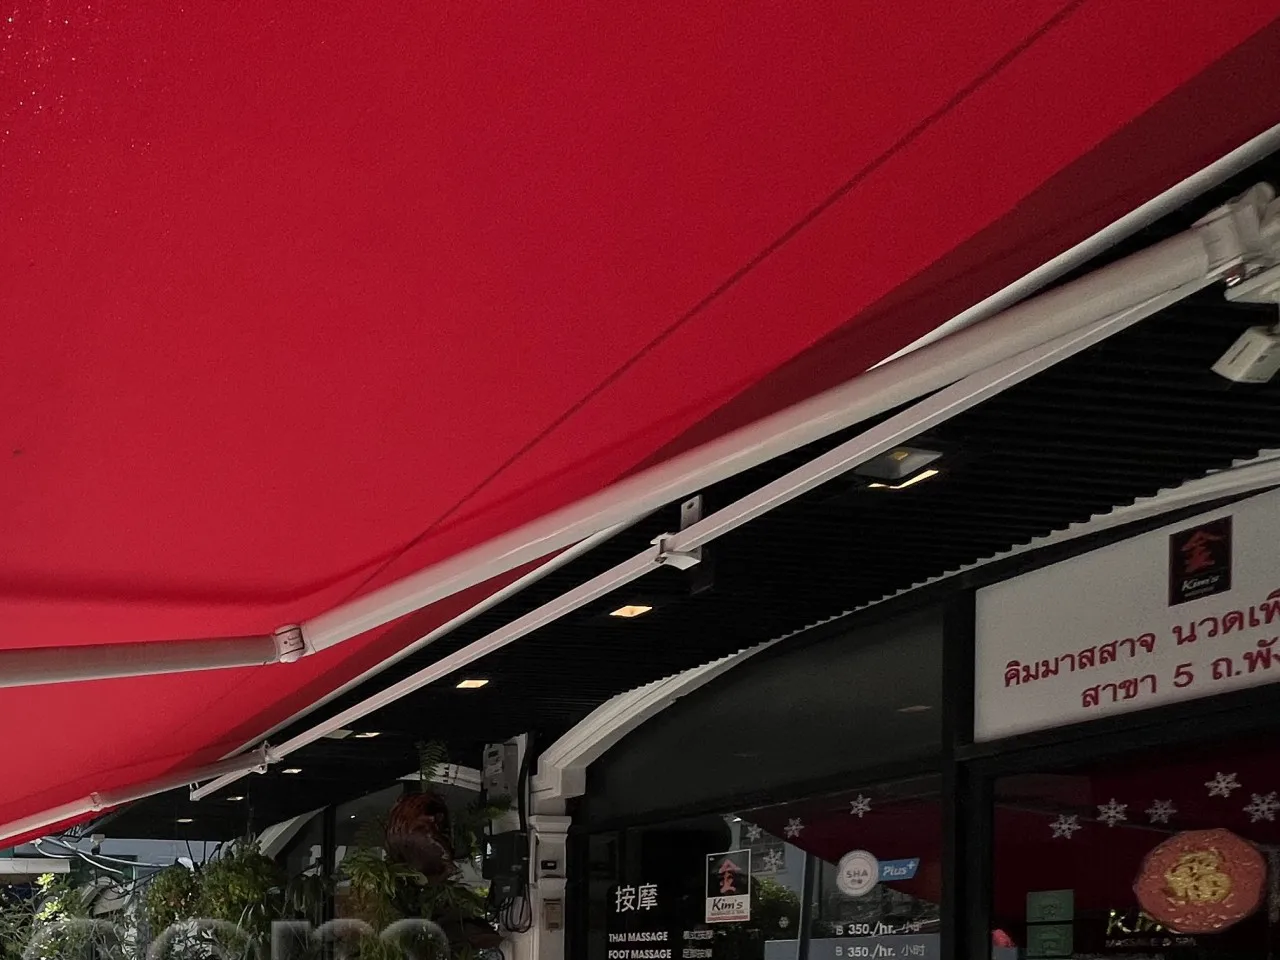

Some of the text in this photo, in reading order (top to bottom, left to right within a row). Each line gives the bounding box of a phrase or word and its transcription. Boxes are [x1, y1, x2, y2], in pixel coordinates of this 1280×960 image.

[1004, 630, 1156, 687] คิมมาสสาจ
[1081, 673, 1158, 708] สาขา
[1173, 663, 1194, 687] 5
[846, 869, 868, 878] SHA
[615, 882, 658, 913] 按摩
[711, 898, 744, 911] Kim's
[609, 931, 668, 942] THAI MASSAGE
[608, 949, 672, 959] FOOT MASSAGE
[901, 944, 925, 957] 小时
